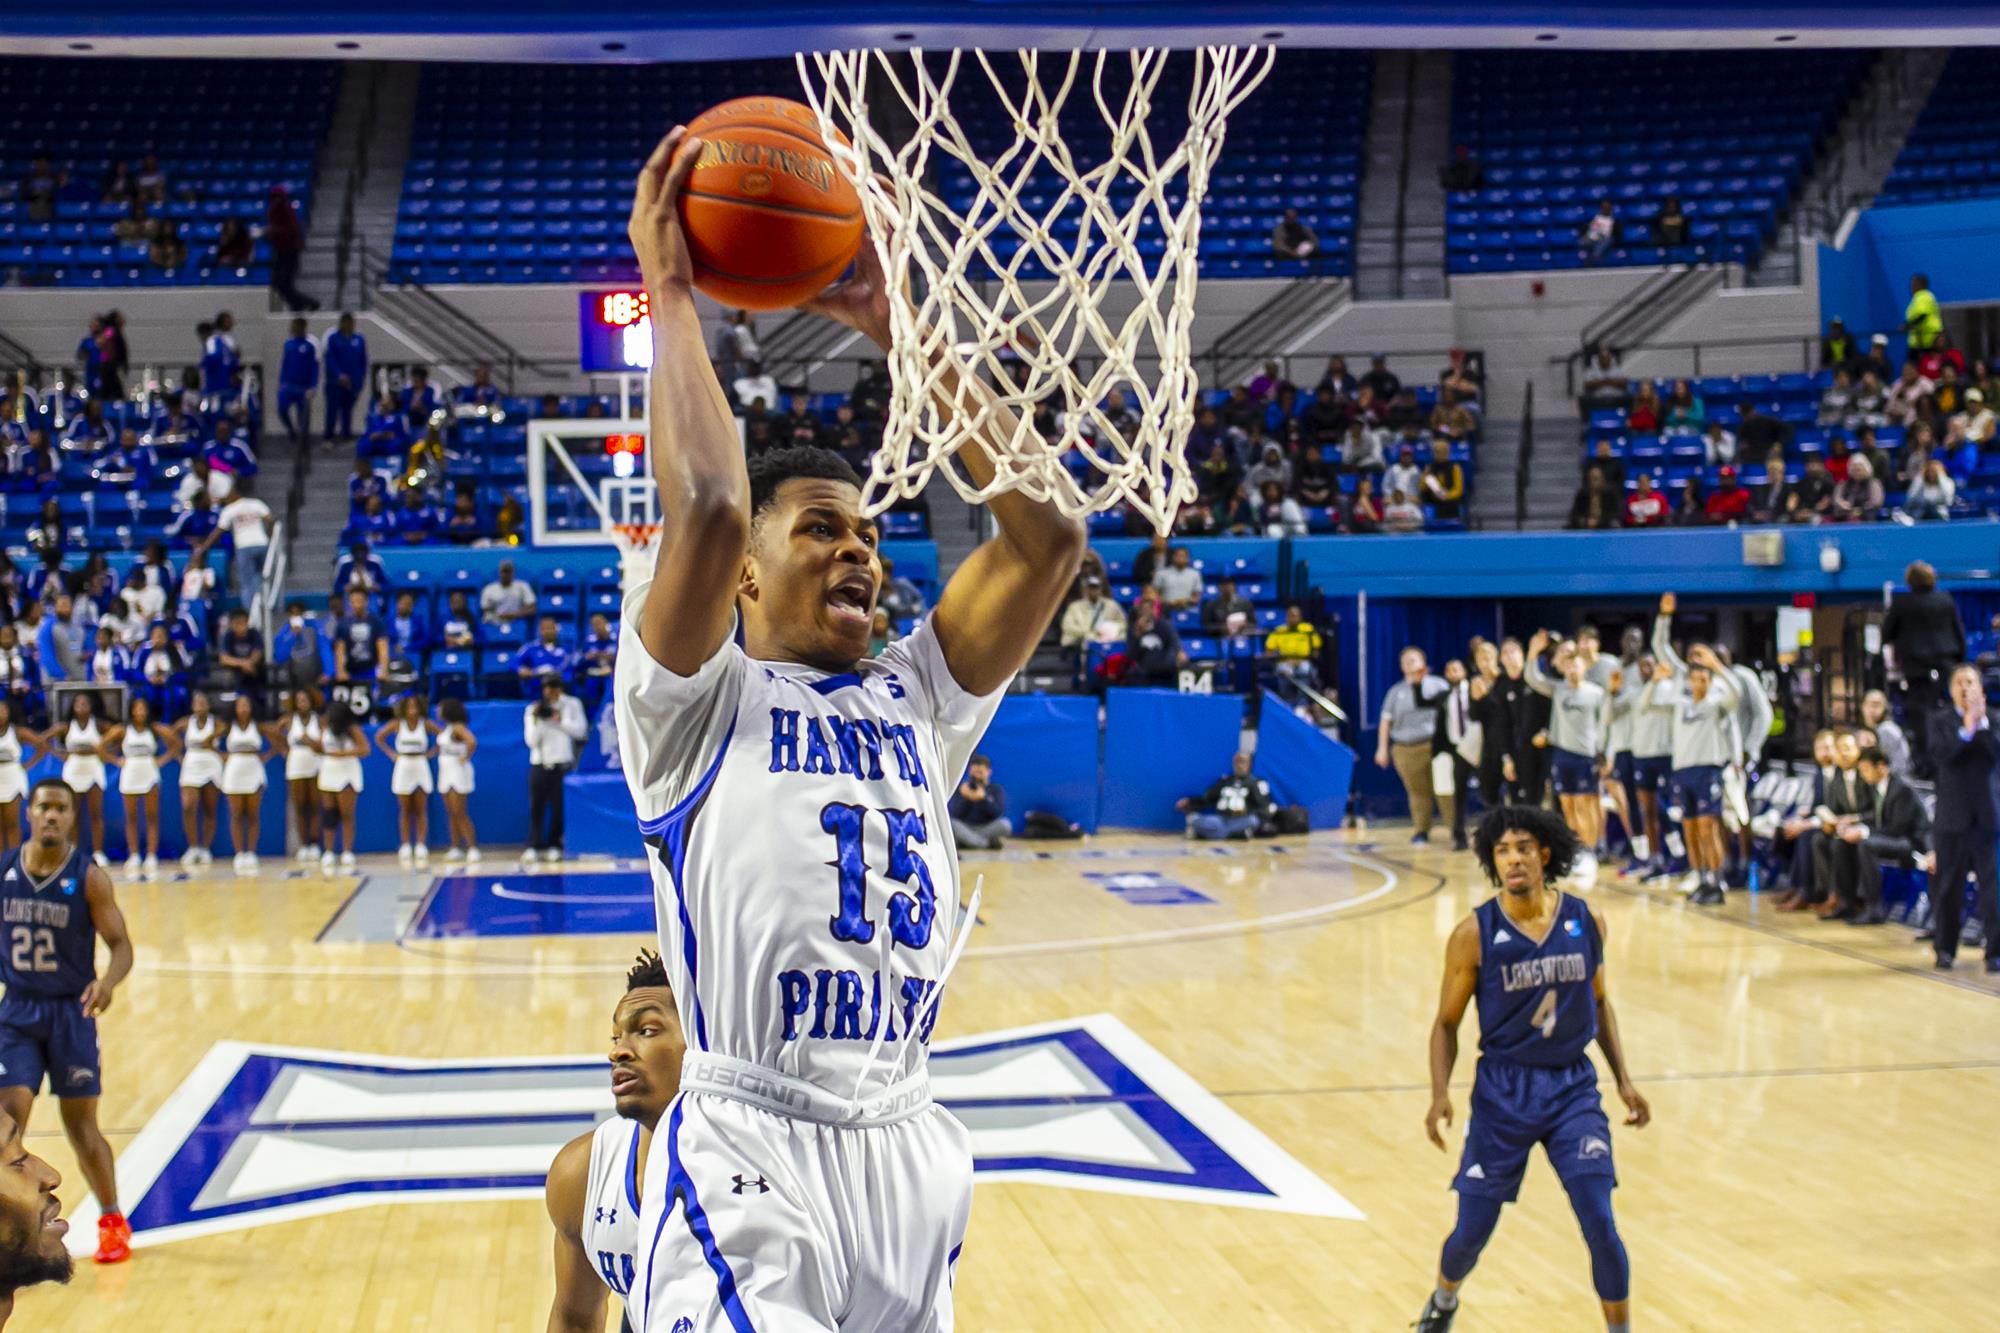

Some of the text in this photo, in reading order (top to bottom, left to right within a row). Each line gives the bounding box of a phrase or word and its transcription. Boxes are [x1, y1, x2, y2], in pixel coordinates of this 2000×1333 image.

[819, 801, 937, 950] 15
[11, 926, 58, 972] 22
[1501, 952, 1587, 992] LONGWOOD
[1530, 988, 1557, 1038] 4
[696, 1063, 811, 1111] UNDER
